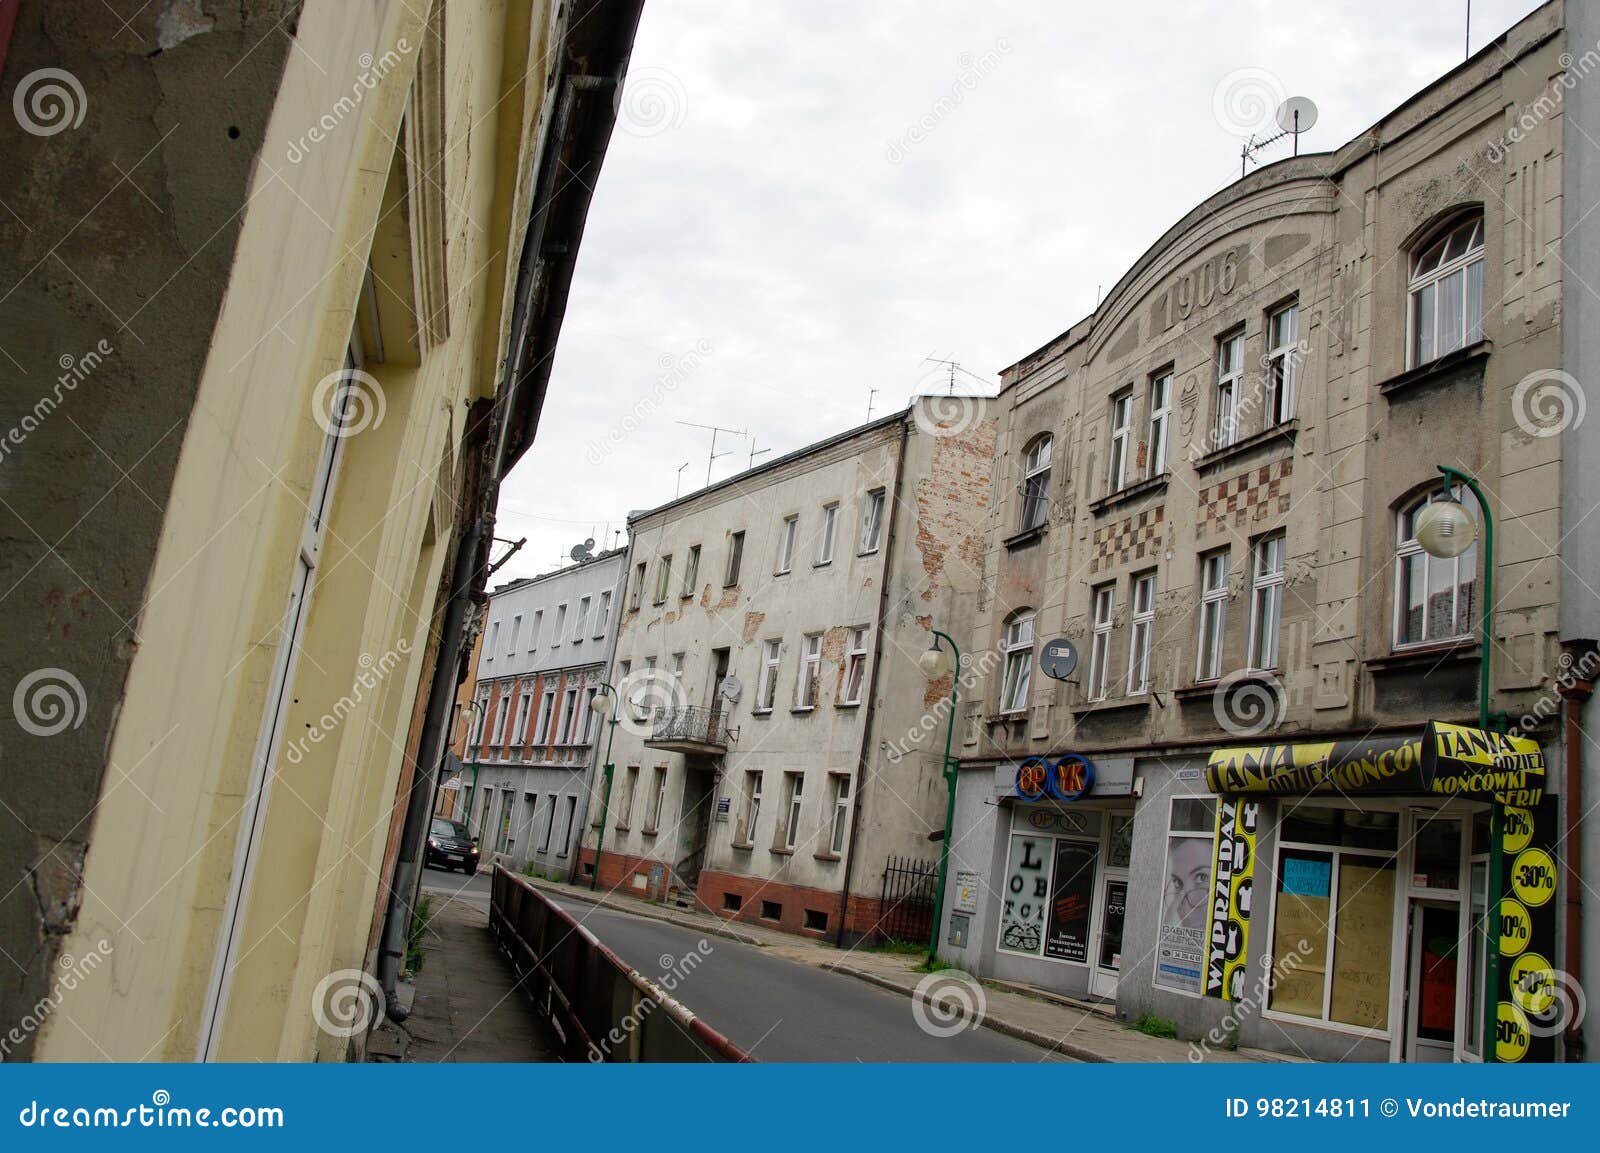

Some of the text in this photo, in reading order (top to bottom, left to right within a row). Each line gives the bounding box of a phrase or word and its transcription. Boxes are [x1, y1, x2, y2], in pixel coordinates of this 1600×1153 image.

[1160, 247, 1239, 326] 1906
[1436, 729, 1517, 757] TANIA
[1207, 744, 1296, 792] TANIA
[1432, 769, 1526, 793] KOŃCÓWKI
[1494, 789, 1542, 806] SERII
[1020, 840, 1042, 870] L
[1515, 865, 1553, 889] -30%
[1513, 970, 1553, 998] -50%
